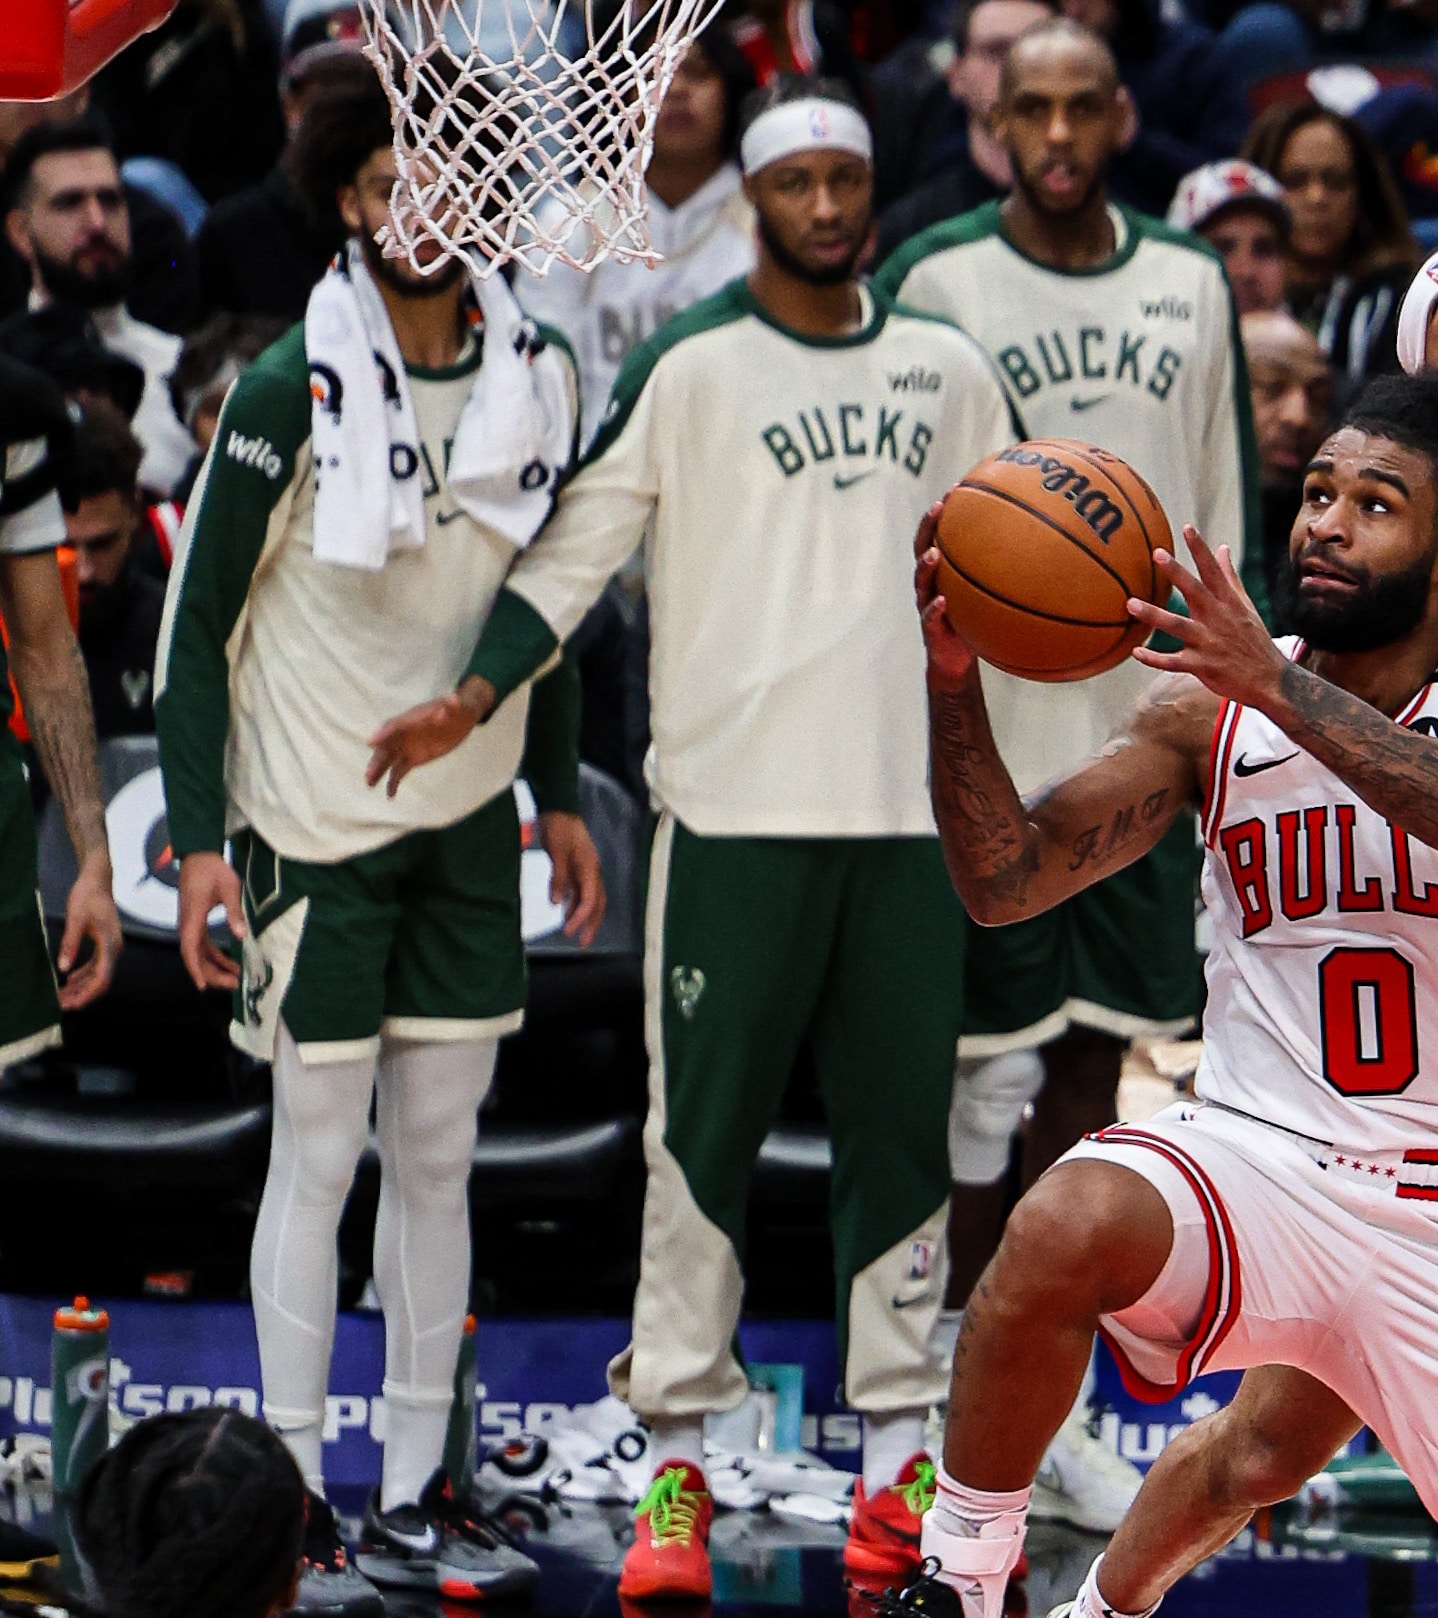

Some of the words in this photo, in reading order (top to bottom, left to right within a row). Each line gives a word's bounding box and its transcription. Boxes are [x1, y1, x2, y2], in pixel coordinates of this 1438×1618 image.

[998, 326, 1181, 402] BUCKS
[763, 403, 933, 478] BUCKS
[995, 449, 1124, 546] Wilson
[1318, 946, 1419, 1097] 0
